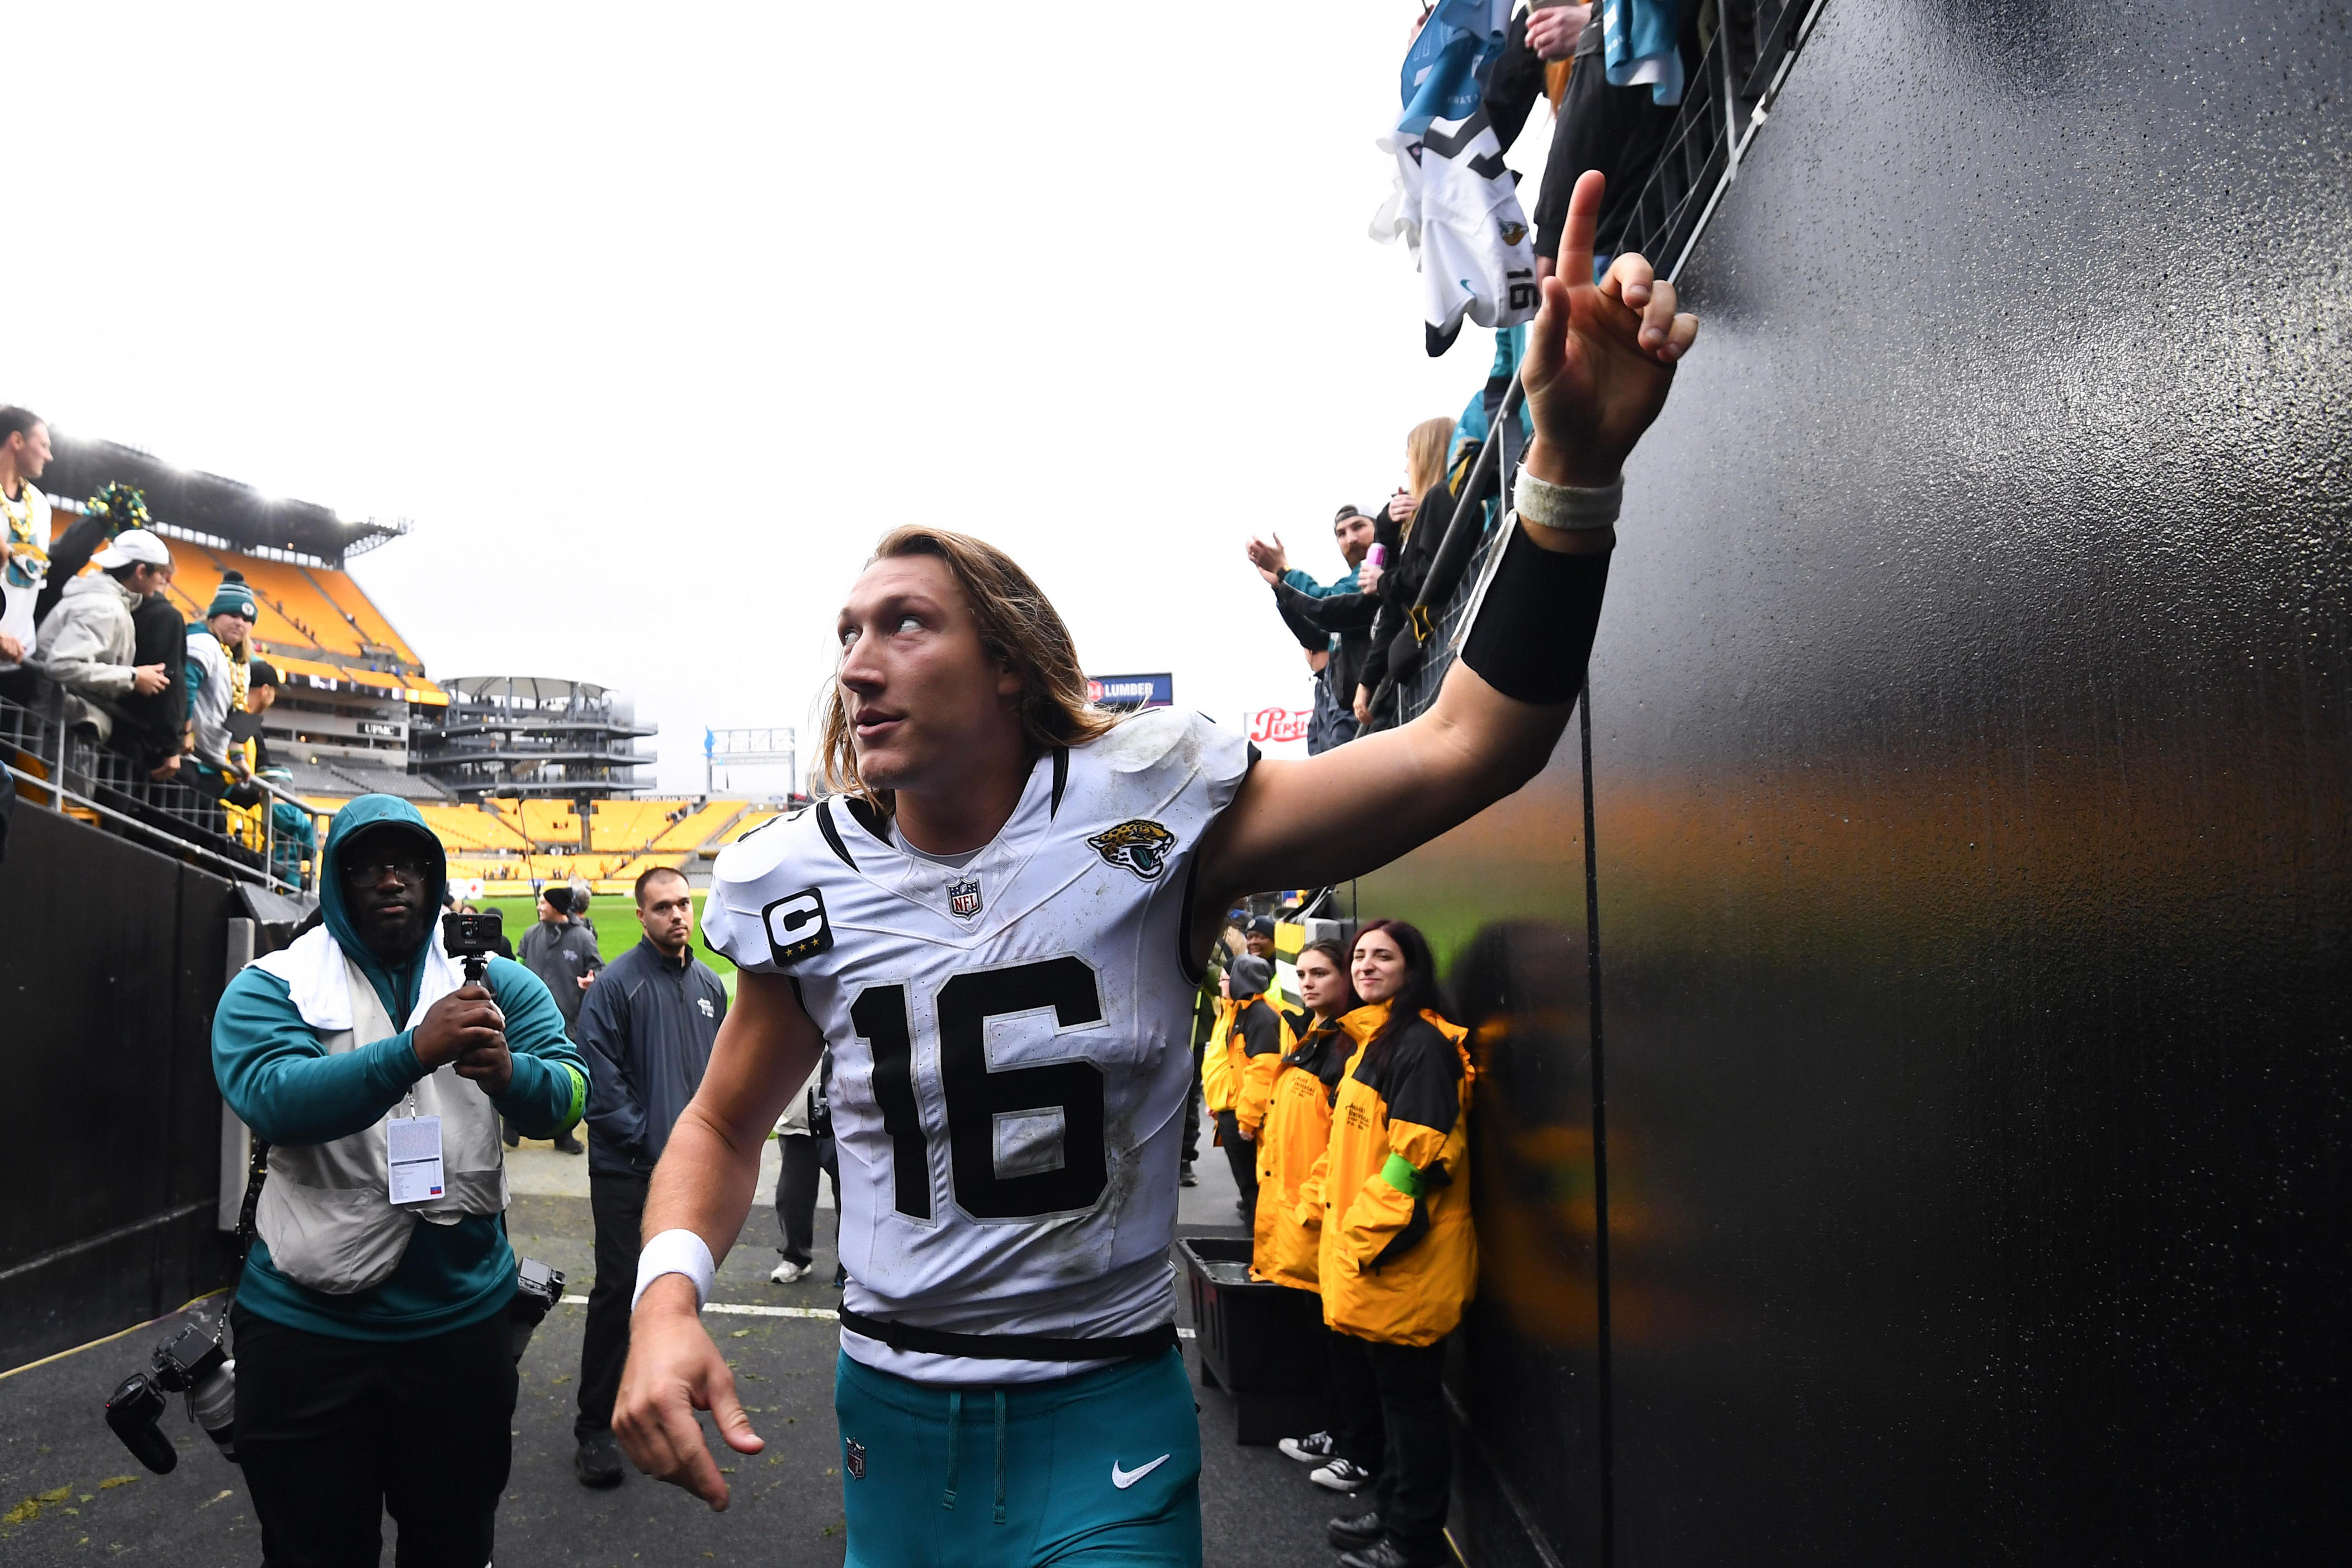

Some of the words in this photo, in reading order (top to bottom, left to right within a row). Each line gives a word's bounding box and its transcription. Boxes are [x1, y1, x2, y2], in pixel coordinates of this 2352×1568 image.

[1507, 267, 1540, 310] 16
[1105, 682, 1154, 697] LUMBER
[365, 723, 394, 736] UPMC
[953, 894, 977, 912] NFL
[769, 894, 822, 946] C
[848, 952, 1110, 1224] 16
